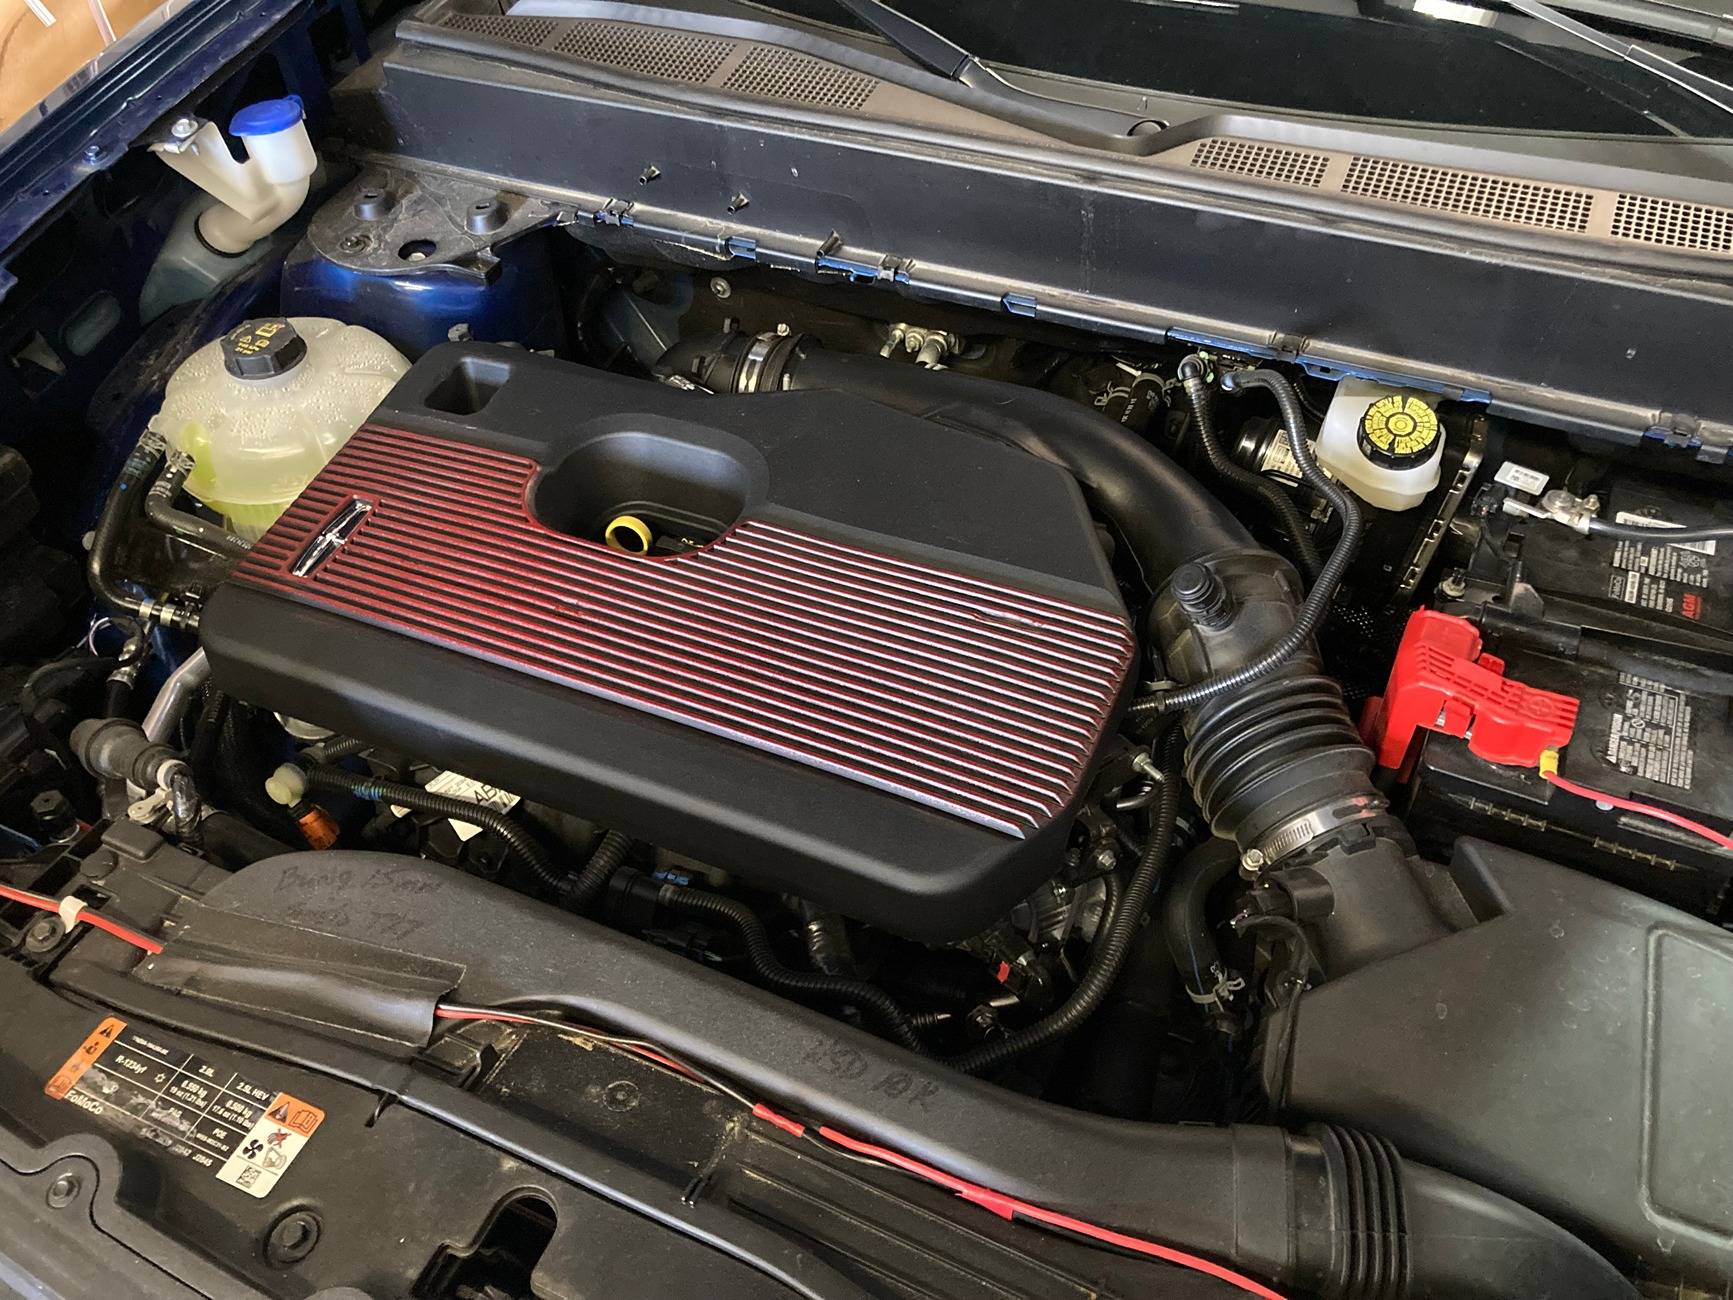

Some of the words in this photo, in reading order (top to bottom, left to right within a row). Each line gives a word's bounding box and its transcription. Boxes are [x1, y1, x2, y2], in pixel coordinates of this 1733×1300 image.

[115, 1055, 147, 1074] R-1234yf
[198, 1087, 207, 1099] kg
[251, 1089, 270, 1100] HEV
[65, 1090, 103, 1115] FoMoCo
